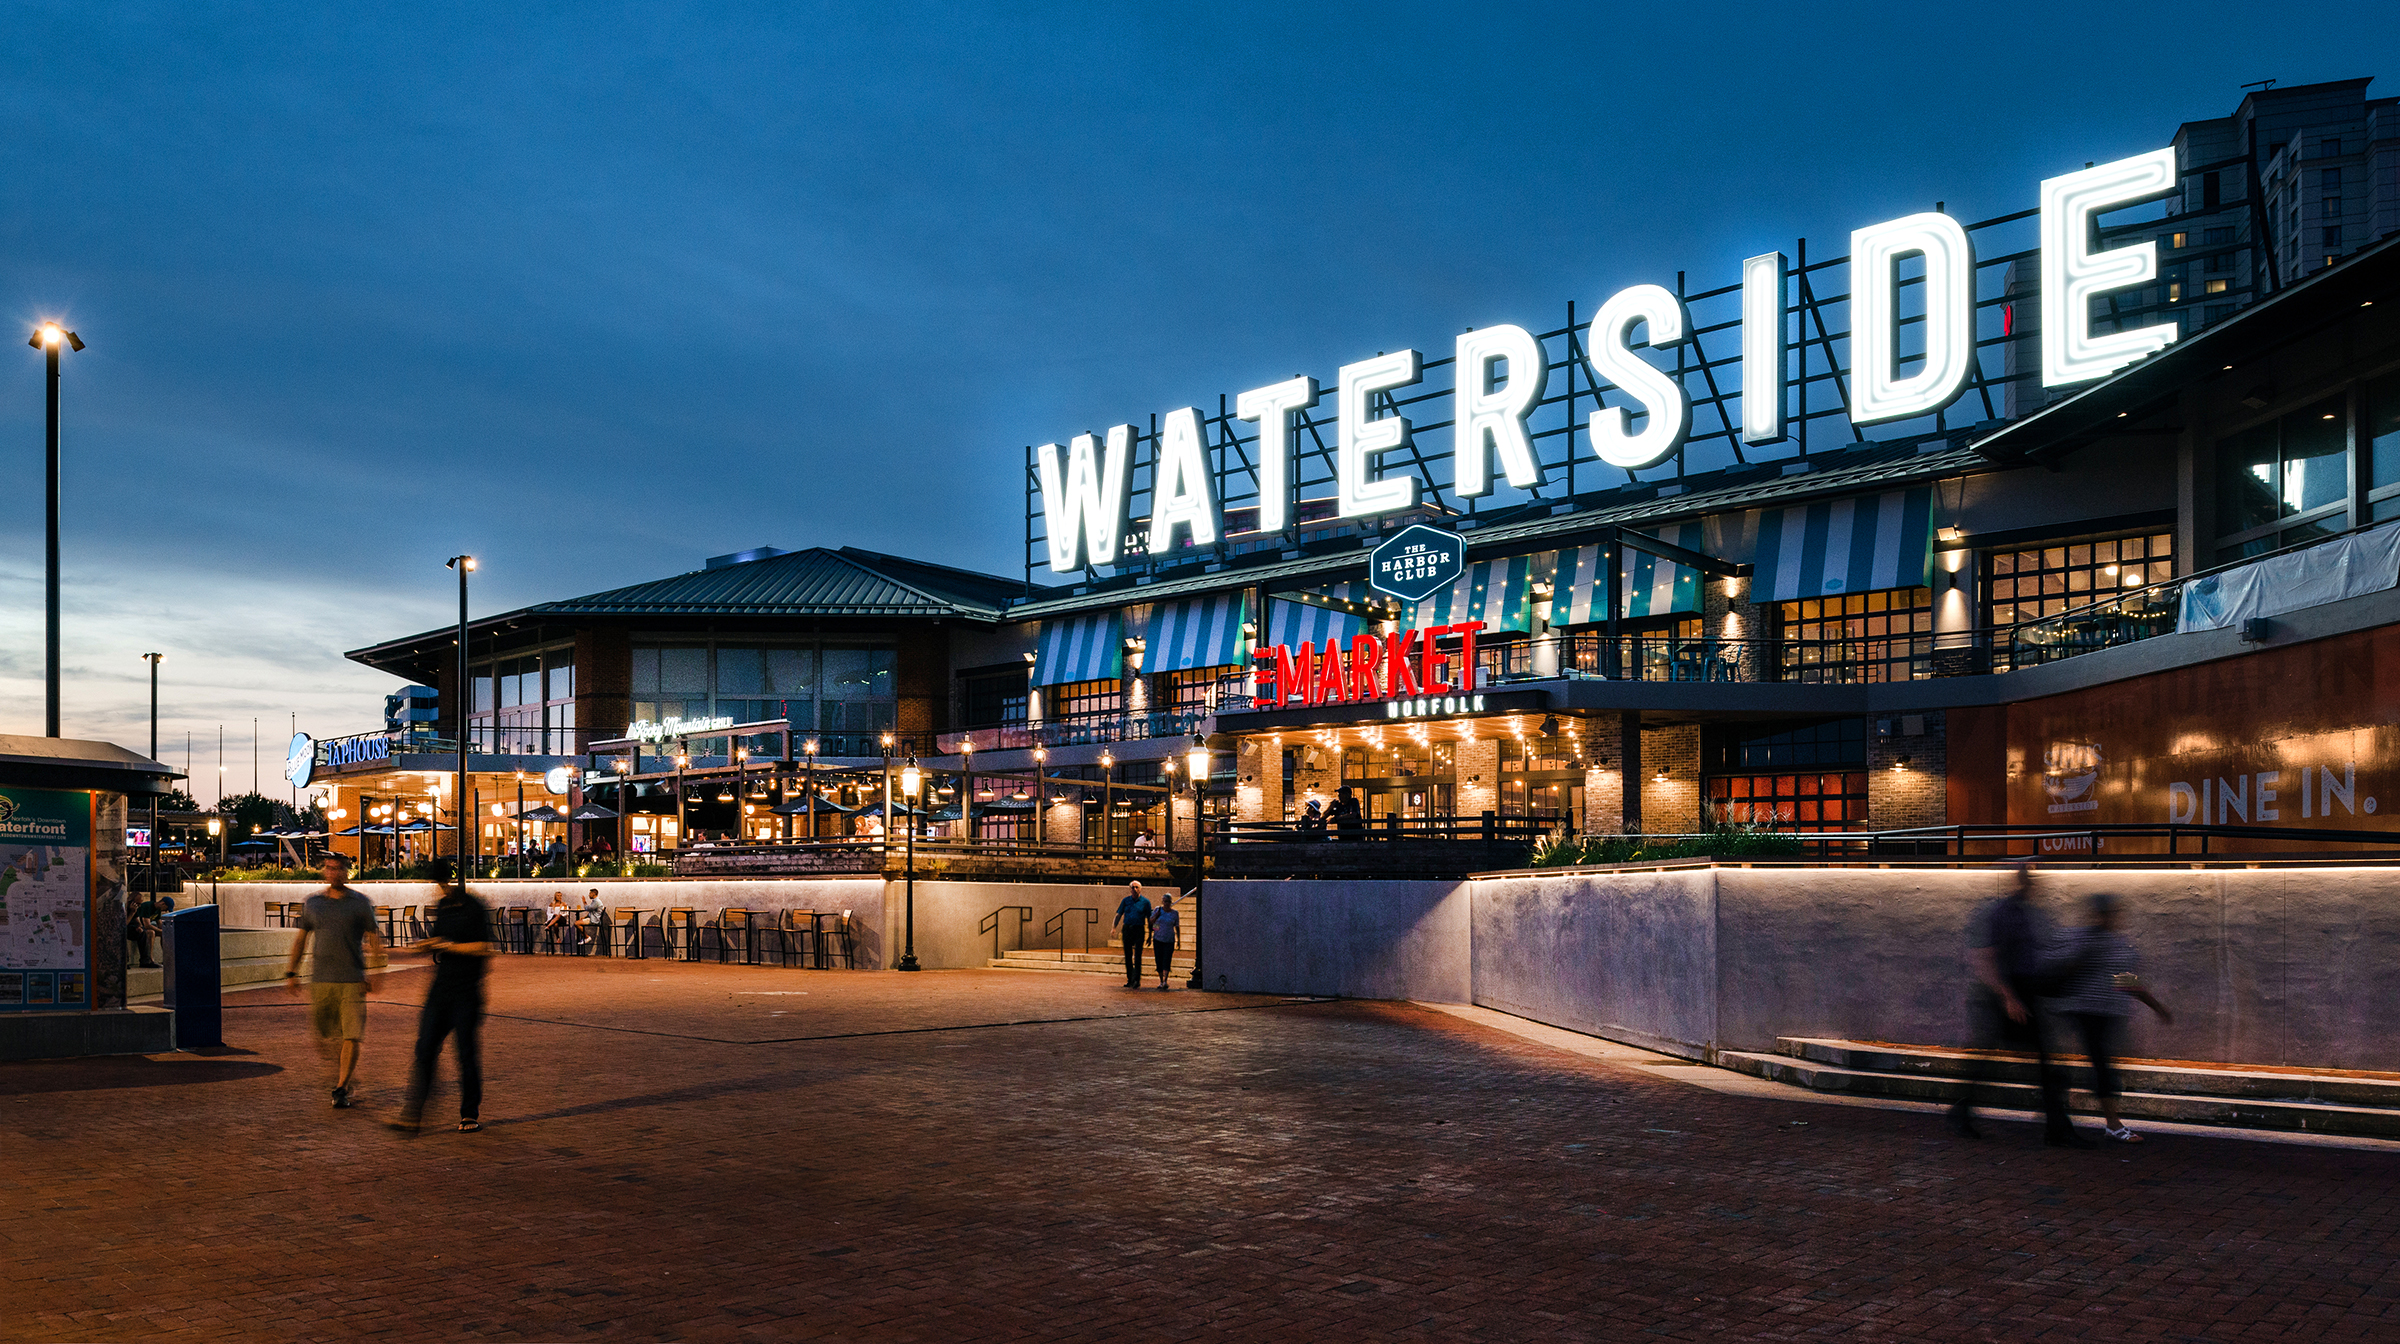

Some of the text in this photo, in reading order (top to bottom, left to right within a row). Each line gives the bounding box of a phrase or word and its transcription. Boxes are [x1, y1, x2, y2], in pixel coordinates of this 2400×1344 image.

[1037, 146, 2178, 573] WATERSIDE
[1404, 544, 1426, 554] THE
[1381, 552, 1450, 572] HARBOR
[1394, 568, 1437, 582] CLUB
[1253, 620, 1487, 709] THE MARKET
[1388, 695, 1485, 718] NORFOLK
[635, 716, 733, 743] Rocky Mountain GRILL
[2169, 762, 2378, 825] DINE IN.
[0, 821, 66, 834] aterfront
